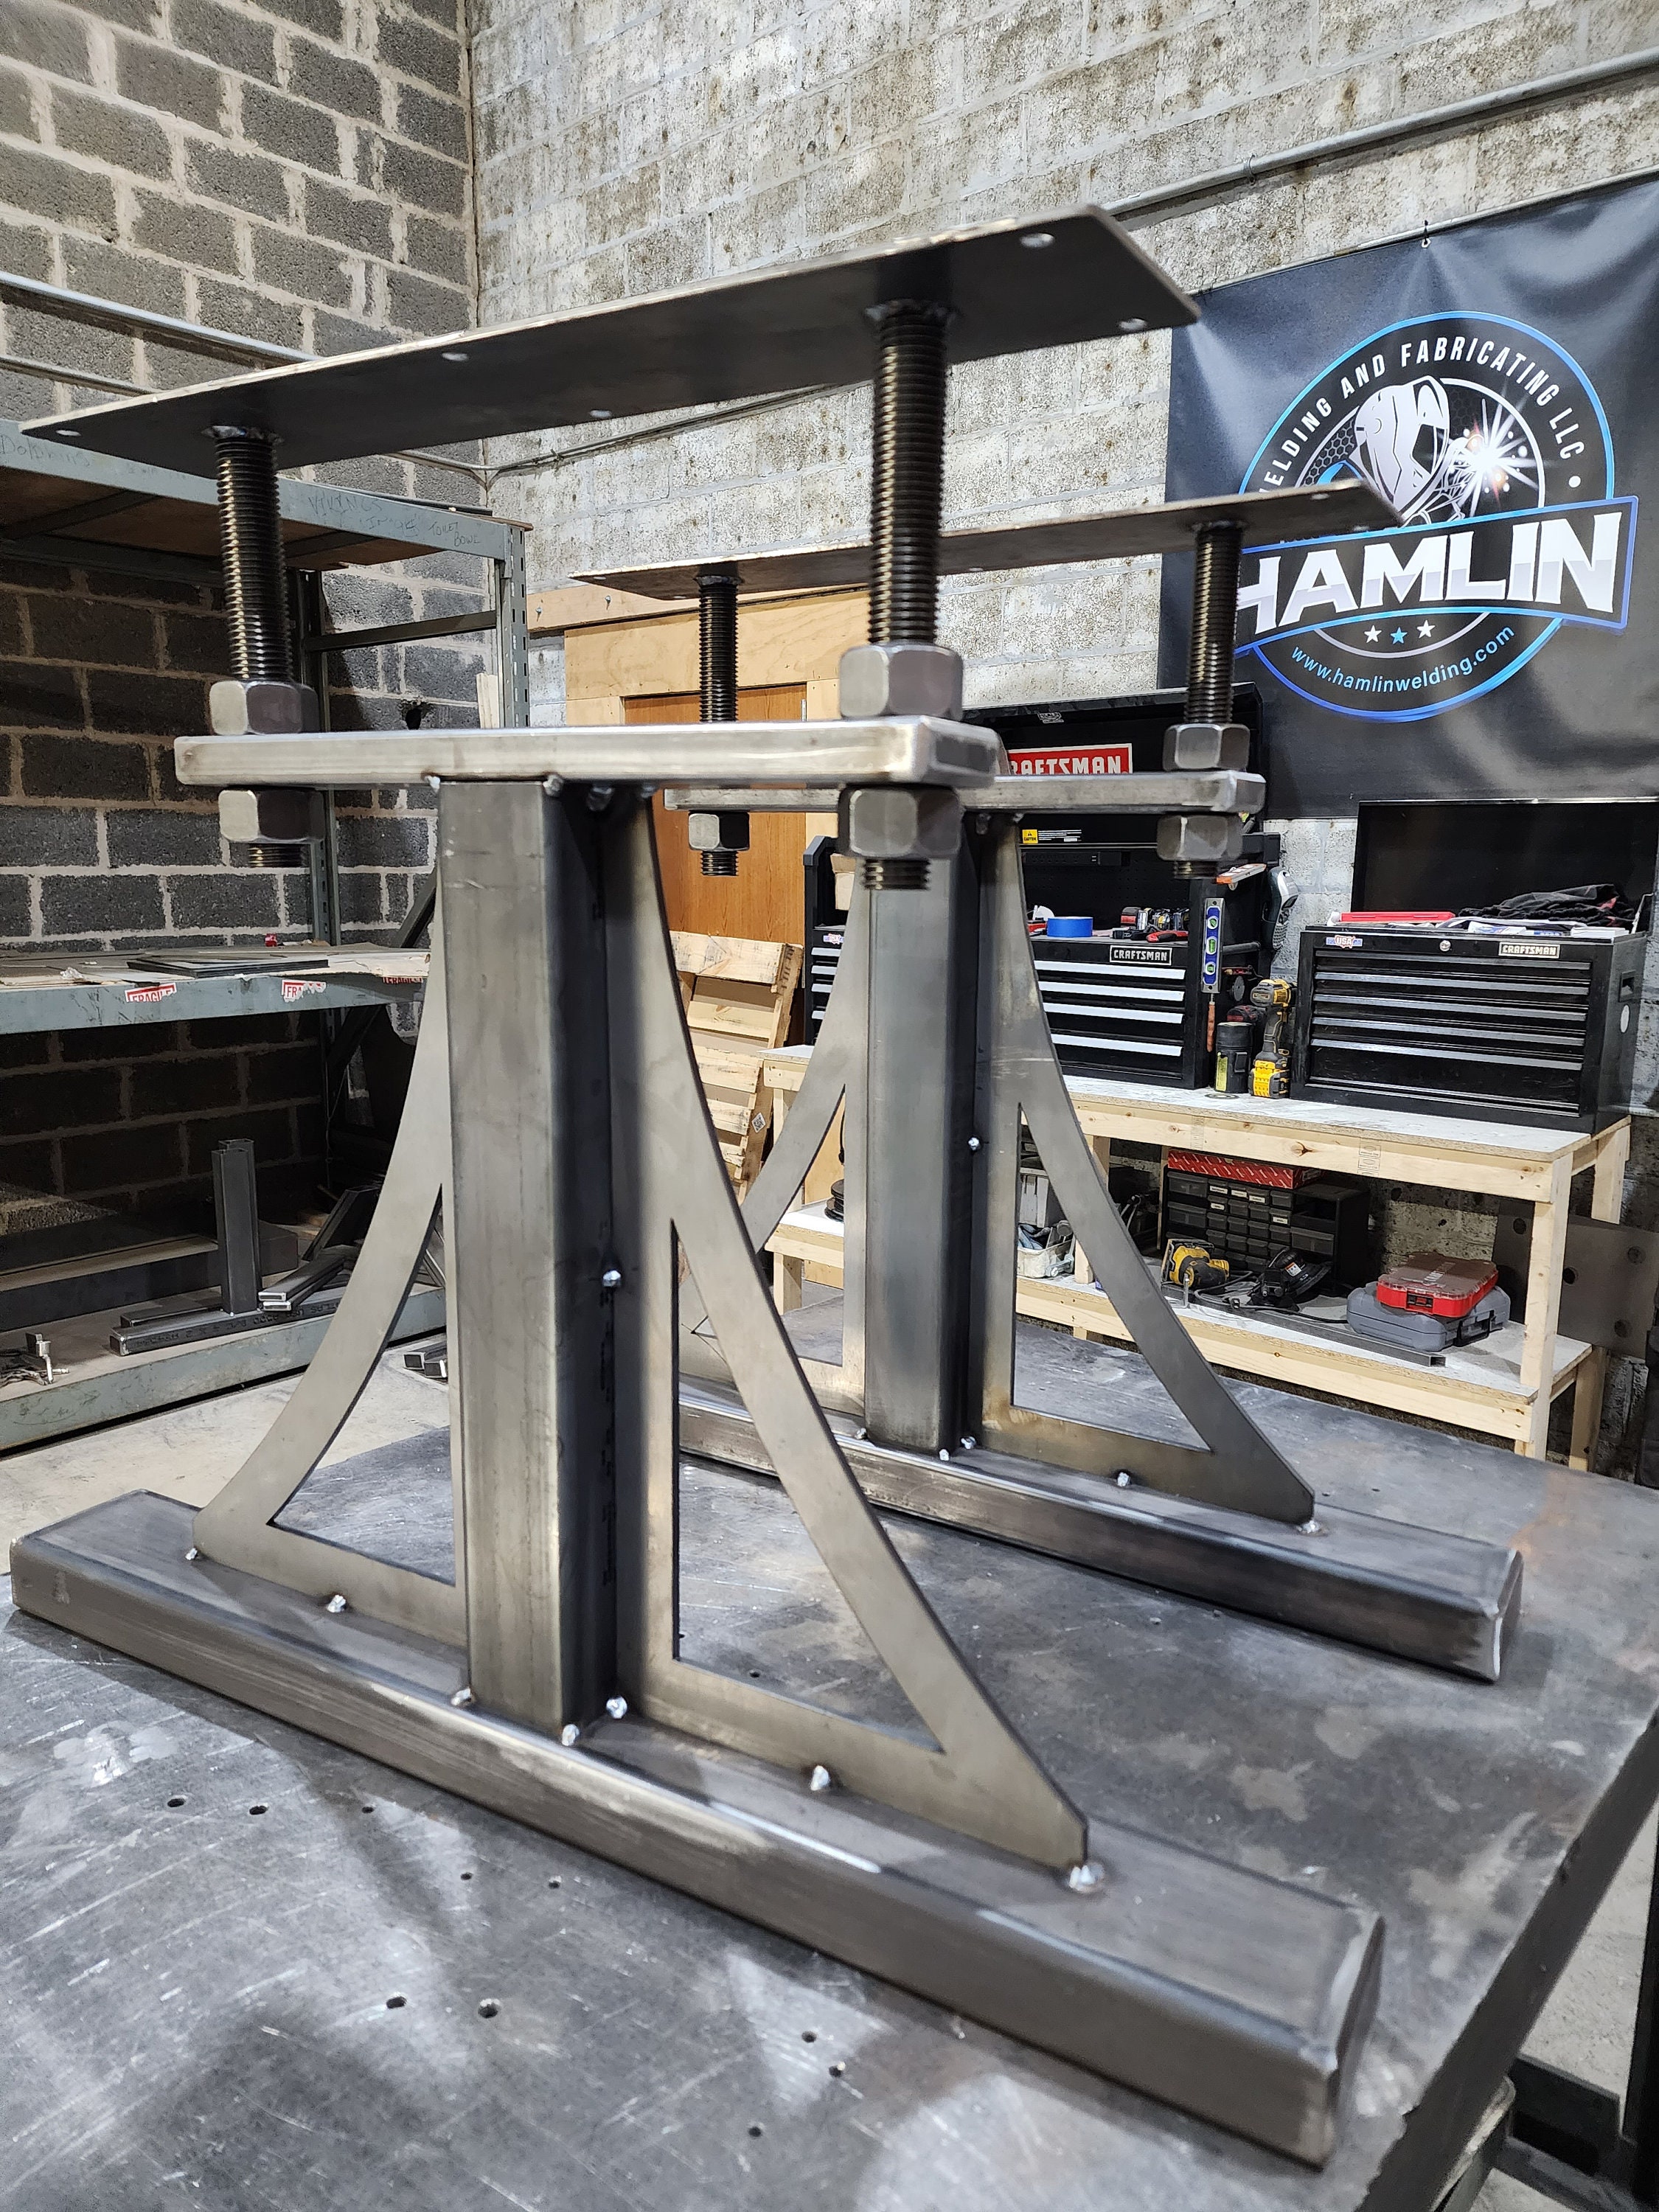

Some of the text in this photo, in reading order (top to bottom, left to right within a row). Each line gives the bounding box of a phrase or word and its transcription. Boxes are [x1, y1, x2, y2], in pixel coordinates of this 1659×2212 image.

[1259, 336, 1585, 493] ELDING AND FABRICATING LLC
[1237, 512, 1621, 634] HAMLIN
[1290, 625, 1515, 692] www.hamlinwelding.com
[1011, 756, 1121, 775] RAFTSMAN
[1336, 937, 1352, 945] USA
[1502, 945, 1557, 956] CRAFTSMAN
[1113, 949, 1167, 961] CRAFTSMAN
